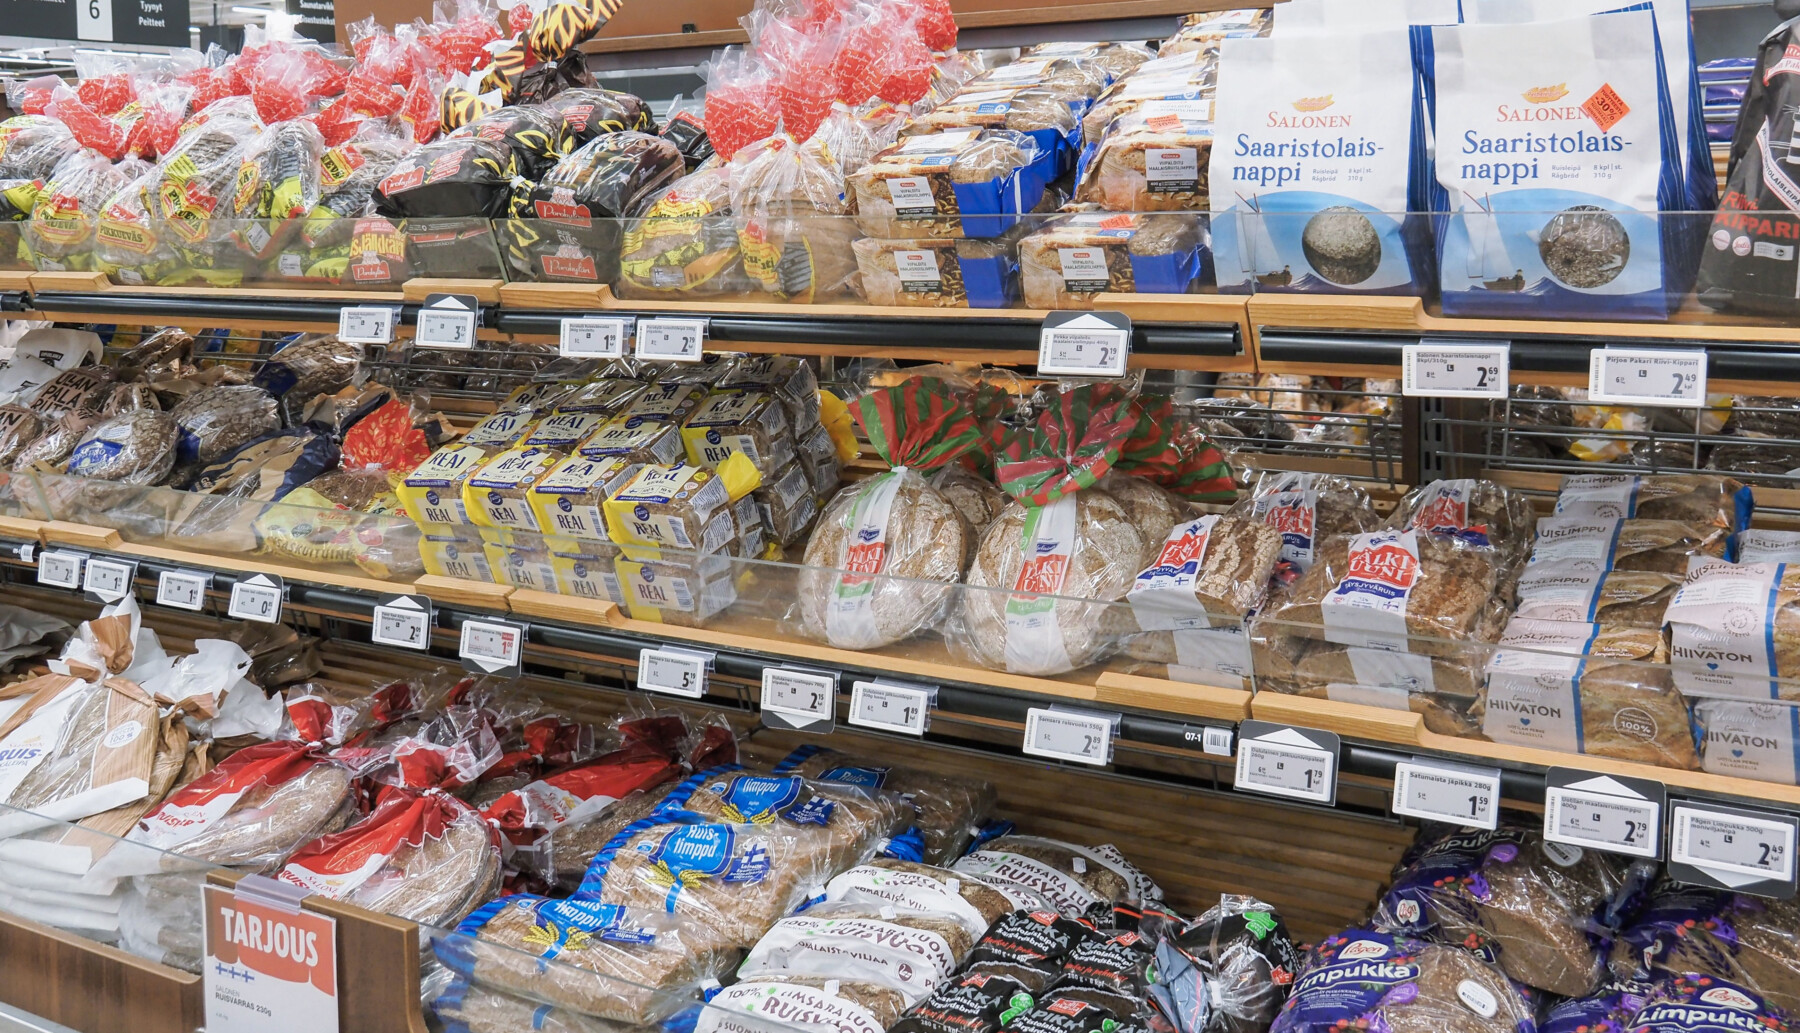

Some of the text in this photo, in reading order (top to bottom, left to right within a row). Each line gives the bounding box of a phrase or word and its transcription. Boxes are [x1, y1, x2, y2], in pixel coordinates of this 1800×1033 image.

[89, 0, 100, 19] 6
[140, 1, 163, 12] Tyynyt
[139, 17, 165, 27] Peitteet
[1267, 111, 1351, 128] SALONEN
[1497, 104, 1590, 122] SALONEN
[1234, 133, 1384, 158] Saaristolais-
[1462, 130, 1632, 154] Saaristolais-
[1233, 162, 1301, 187] nappi
[1461, 158, 1539, 185] nappi
[426, 507, 454, 522] REAL
[489, 507, 518, 521] REAL
[557, 514, 587, 531] REAL
[633, 521, 665, 539] REAL
[446, 561, 472, 577] REAL
[572, 580, 600, 596] REAL
[637, 584, 668, 601] REAL
[1672, 645, 1752, 663] HIIVATON
[1489, 699, 1561, 719] HIIVATON
[1620, 720, 1651, 734] 100%
[742, 778, 780, 793] limppu
[1409, 771, 1447, 783] Satumaista
[1474, 783, 1491, 791] 280g
[1712, 820, 1745, 831] Limpukka
[673, 840, 718, 860] limppu
[220, 906, 319, 967] TARJOUS
[1290, 960, 1411, 997] Limpukka
[215, 992, 272, 1017] RUISVARRAS 230g
